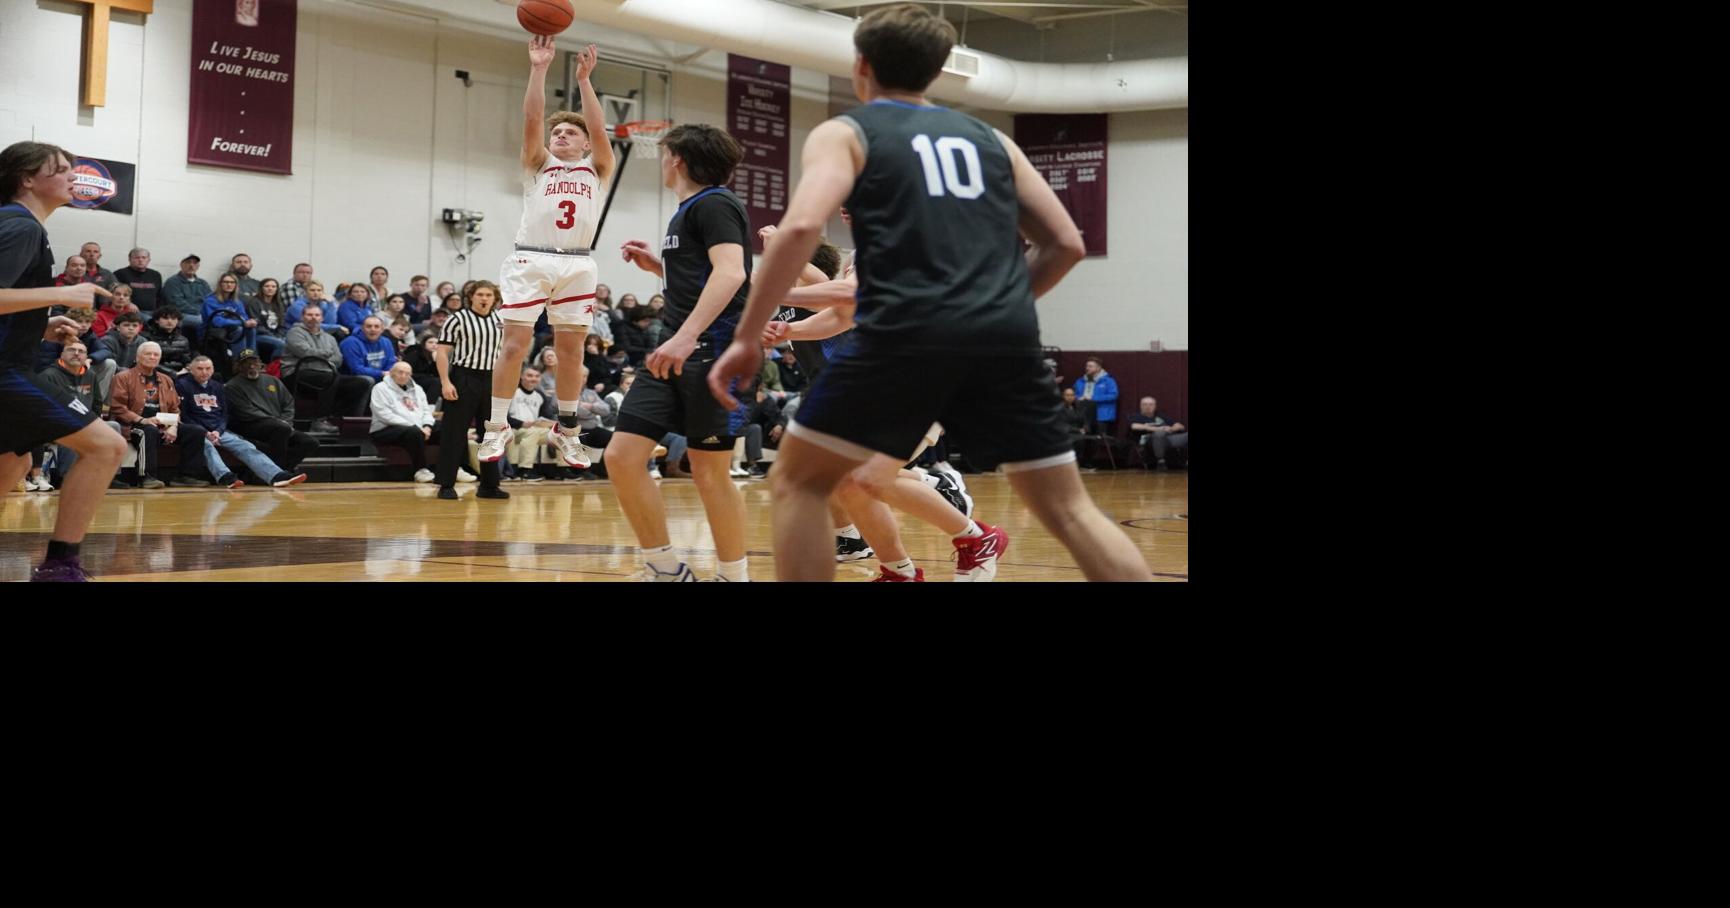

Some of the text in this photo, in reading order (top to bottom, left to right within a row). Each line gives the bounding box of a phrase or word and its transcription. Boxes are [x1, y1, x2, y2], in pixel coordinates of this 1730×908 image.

[210, 41, 280, 64] LIVE JESUS
[198, 59, 289, 83] IN OUR HEARTS
[211, 137, 272, 157] FOREVER!
[1057, 150, 1104, 162] LACROSSE
[911, 133, 986, 200] 10
[544, 181, 592, 200] RANDOLPH
[556, 200, 576, 230] 3
[67, 396, 89, 415] W
